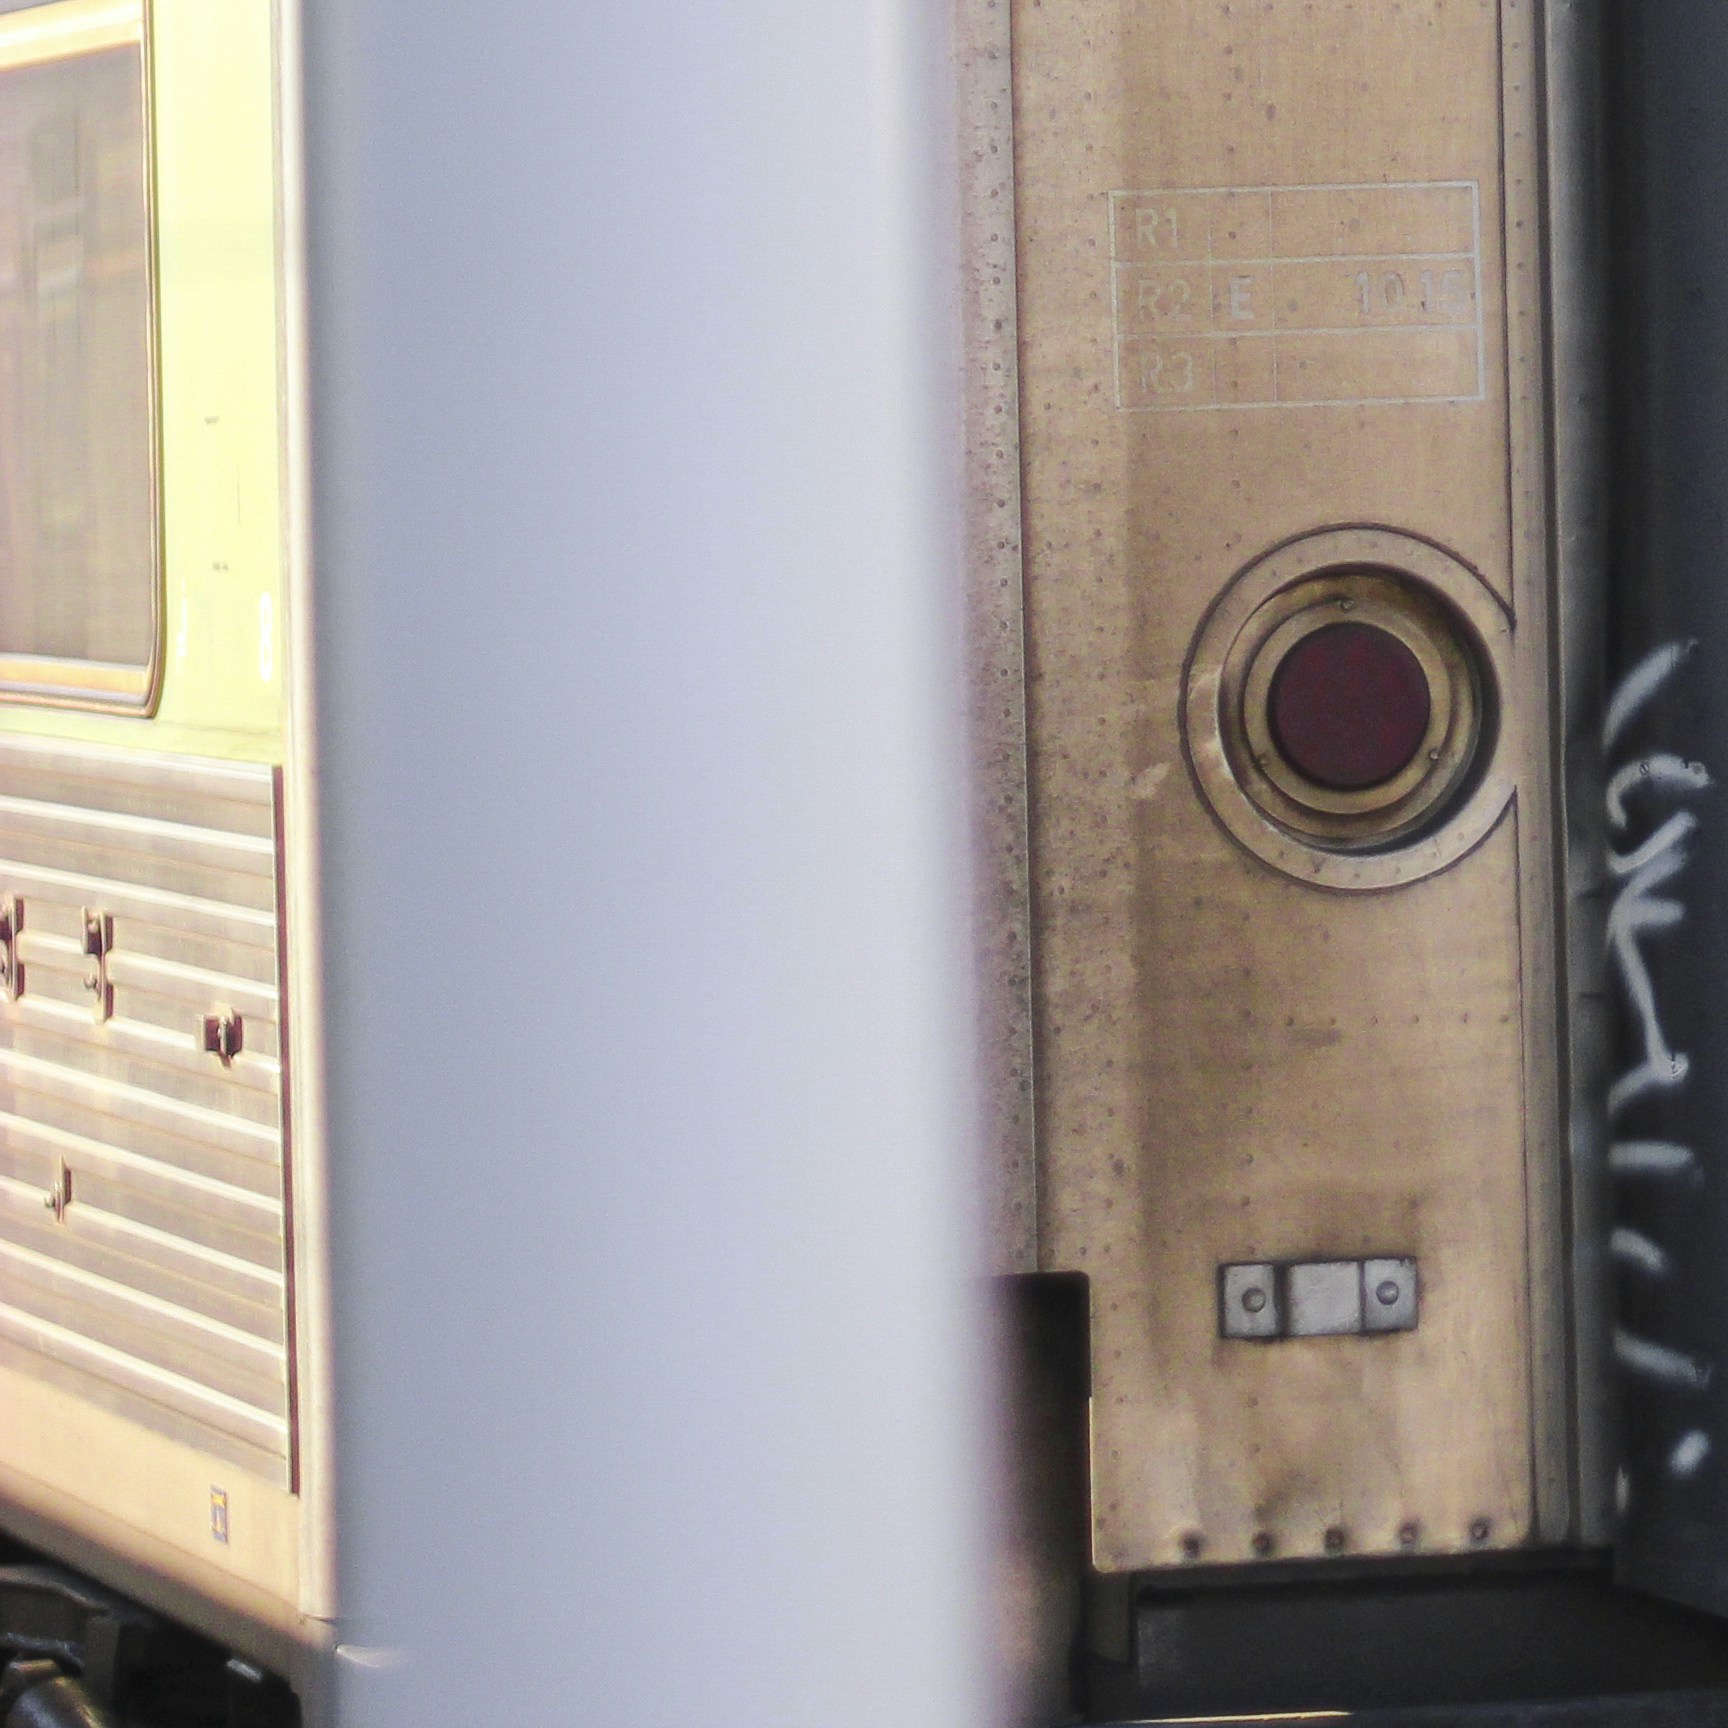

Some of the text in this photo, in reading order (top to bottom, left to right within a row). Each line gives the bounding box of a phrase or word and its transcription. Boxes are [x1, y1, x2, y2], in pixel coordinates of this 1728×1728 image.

[1135, 207, 1178, 249] R1
[1137, 277, 1192, 320] R2
[1230, 275, 1254, 321] E
